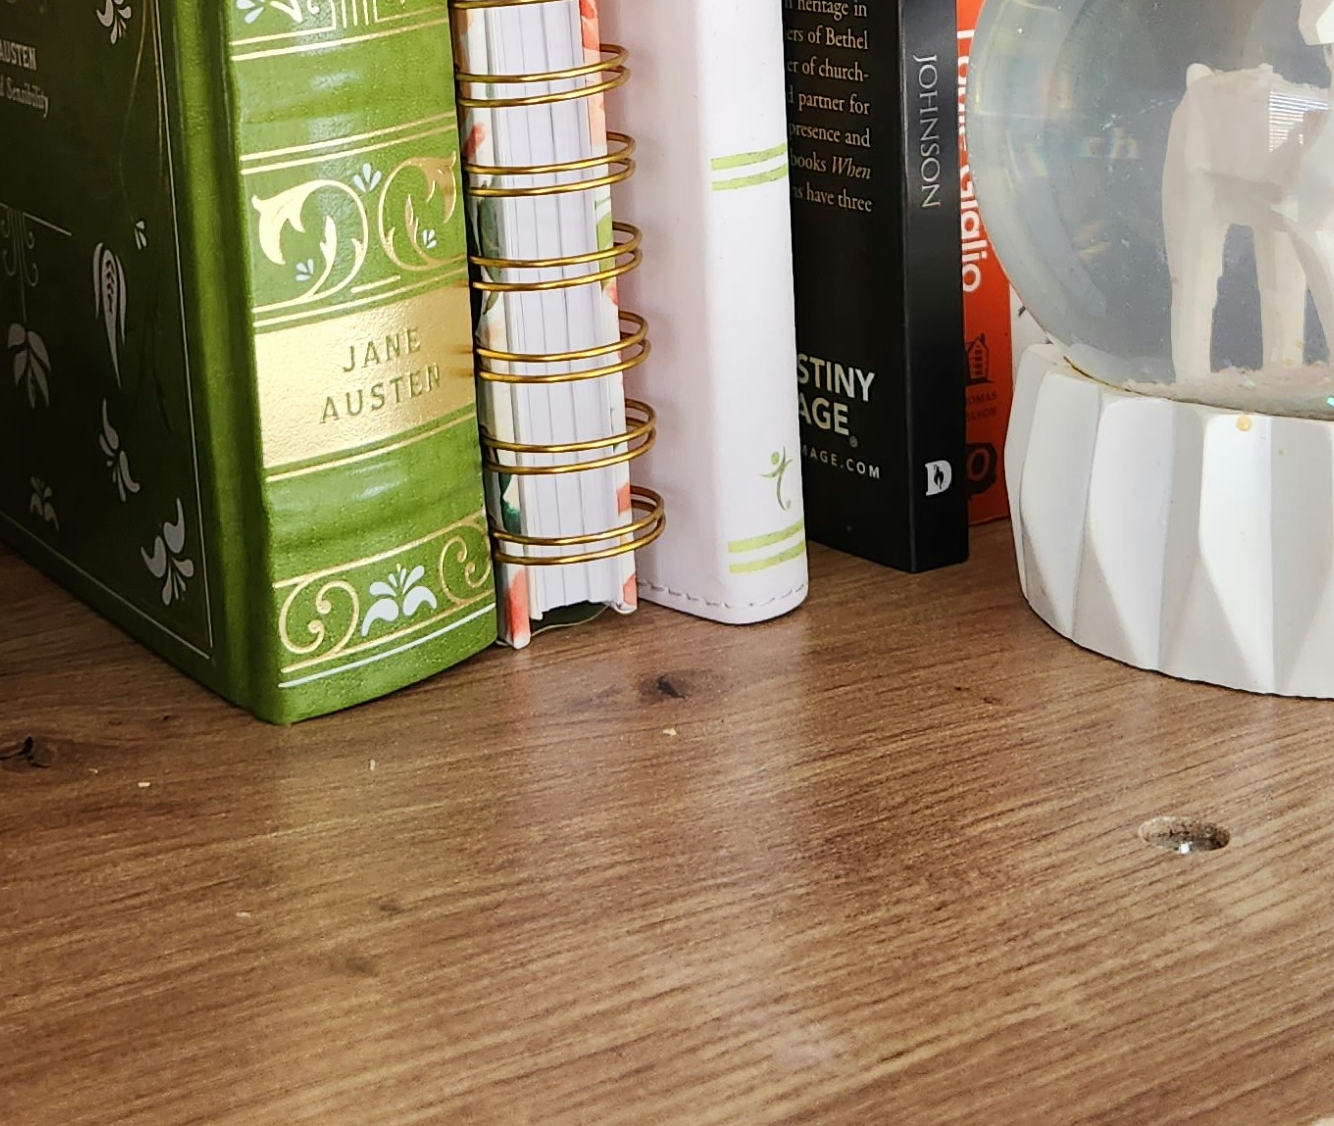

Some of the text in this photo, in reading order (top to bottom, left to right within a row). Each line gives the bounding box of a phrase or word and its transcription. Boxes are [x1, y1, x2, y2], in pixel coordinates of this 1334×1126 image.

[807, 24, 824, 44] of
[825, 26, 869, 50] Bethel
[802, 55, 818, 75] of
[818, 57, 870, 82] church-
[798, 89, 846, 112] partner
[849, 93, 870, 115] for
[788, 122, 871, 149] presence and
[913, 53, 942, 208] JOHNSON
[789, 147, 871, 180] books When
[806, 183, 835, 206] have
[837, 188, 873, 213] three
[342, 327, 421, 374] JANE
[319, 362, 441, 425] AUSTEN
